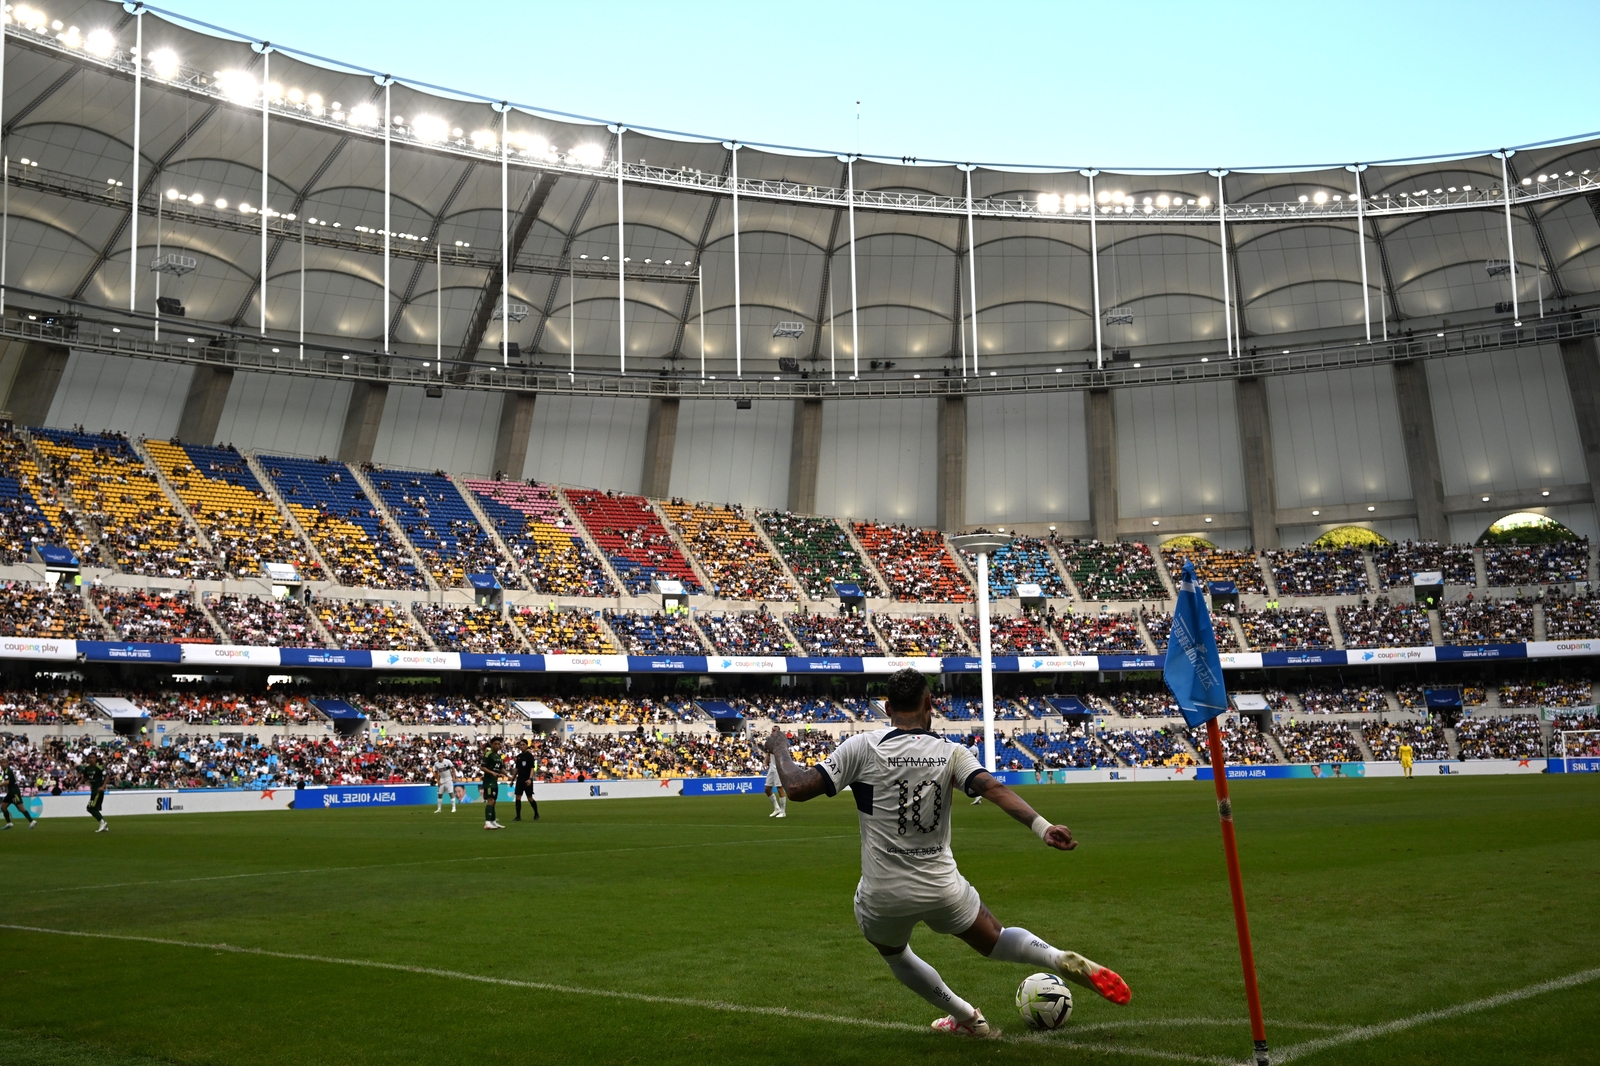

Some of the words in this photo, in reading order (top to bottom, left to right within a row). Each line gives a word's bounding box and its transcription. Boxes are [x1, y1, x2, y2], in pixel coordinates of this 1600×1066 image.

[4, 642, 40, 652] coupang
[42, 644, 58, 653] play
[1556, 643, 1590, 651] coupang
[215, 649, 250, 658] coupang
[403, 656, 432, 664] coupang
[432, 656, 446, 664] play
[1073, 659, 1085, 667] play
[1439, 765, 1451, 774] SNL
[1110, 771, 1120, 780] SNL
[590, 786, 601, 796] SNL
[702, 784, 714, 792] SNL
[716, 783, 735, 791] 코리아
[736, 782, 752, 790] 시즌4
[323, 794, 340, 804] SNL
[343, 793, 370, 803] 코리아
[372, 792, 396, 802] 시즌4
[156, 797, 172, 811] SNL
[892, 780, 941, 835] 10
